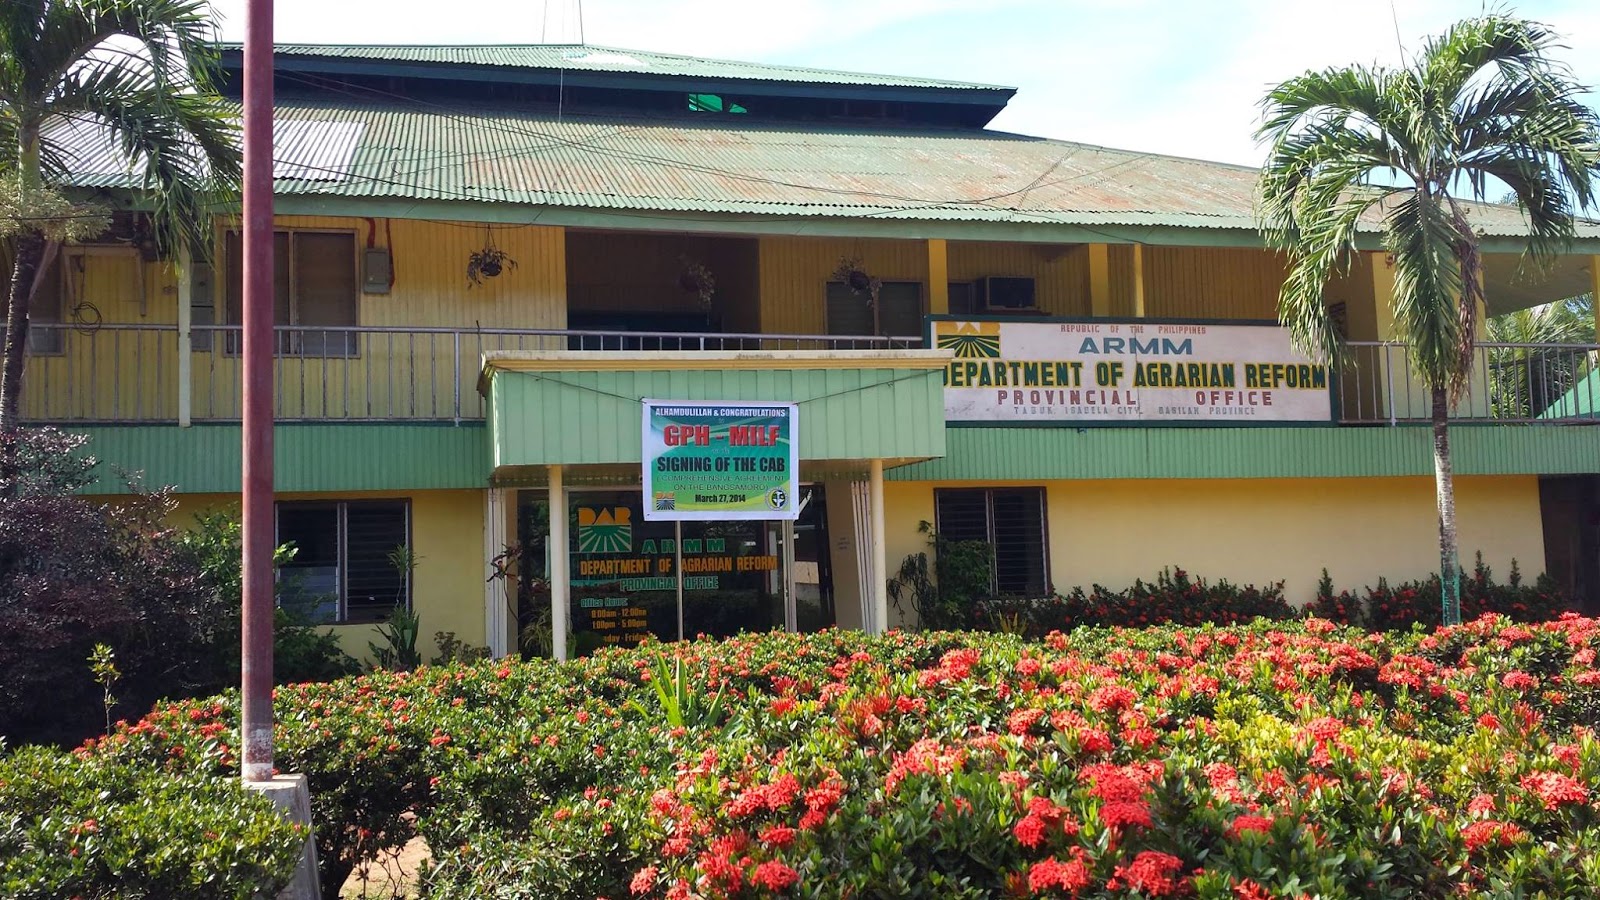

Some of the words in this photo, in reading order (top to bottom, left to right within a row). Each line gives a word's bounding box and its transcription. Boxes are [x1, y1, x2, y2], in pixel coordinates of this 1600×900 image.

[1061, 324, 1100, 333] REPUBLIC
[1110, 325, 1120, 333] OF
[1130, 325, 1144, 334] THE
[1158, 326, 1206, 334] PHILIPPINES
[1078, 337, 1192, 355] ARMM
[1096, 361, 1124, 387] OF
[1133, 362, 1235, 388] AGRARIAN
[1244, 363, 1326, 389] REFORM
[997, 390, 1137, 405] PROVINCIAL
[1195, 391, 1272, 406] OFFICE
[655, 407, 713, 417] ALHAMDULILLAH
[713, 408, 720, 417] &
[720, 408, 786, 417] CONGRATULATIONS
[1065, 407, 1109, 415] ISABELA
[1159, 407, 1200, 415] BASILAN
[1209, 406, 1255, 415] PROVINCE
[663, 424, 710, 447] GPH
[729, 425, 780, 447] MILF
[657, 456, 712, 472] SIGNING
[715, 457, 730, 472] OF
[733, 457, 757, 472] THE
[760, 457, 785, 472] CAB
[695, 494, 717, 503] March
[578, 507, 631, 526] DAR
[580, 559, 651, 575] DEPARTMENT
[659, 558, 671, 573] OF
[681, 556, 732, 572] AGRARIAN
[737, 556, 778, 571] REFORM
[620, 577, 677, 592] PROVINCIAL
[684, 576, 719, 590] OFFICE
